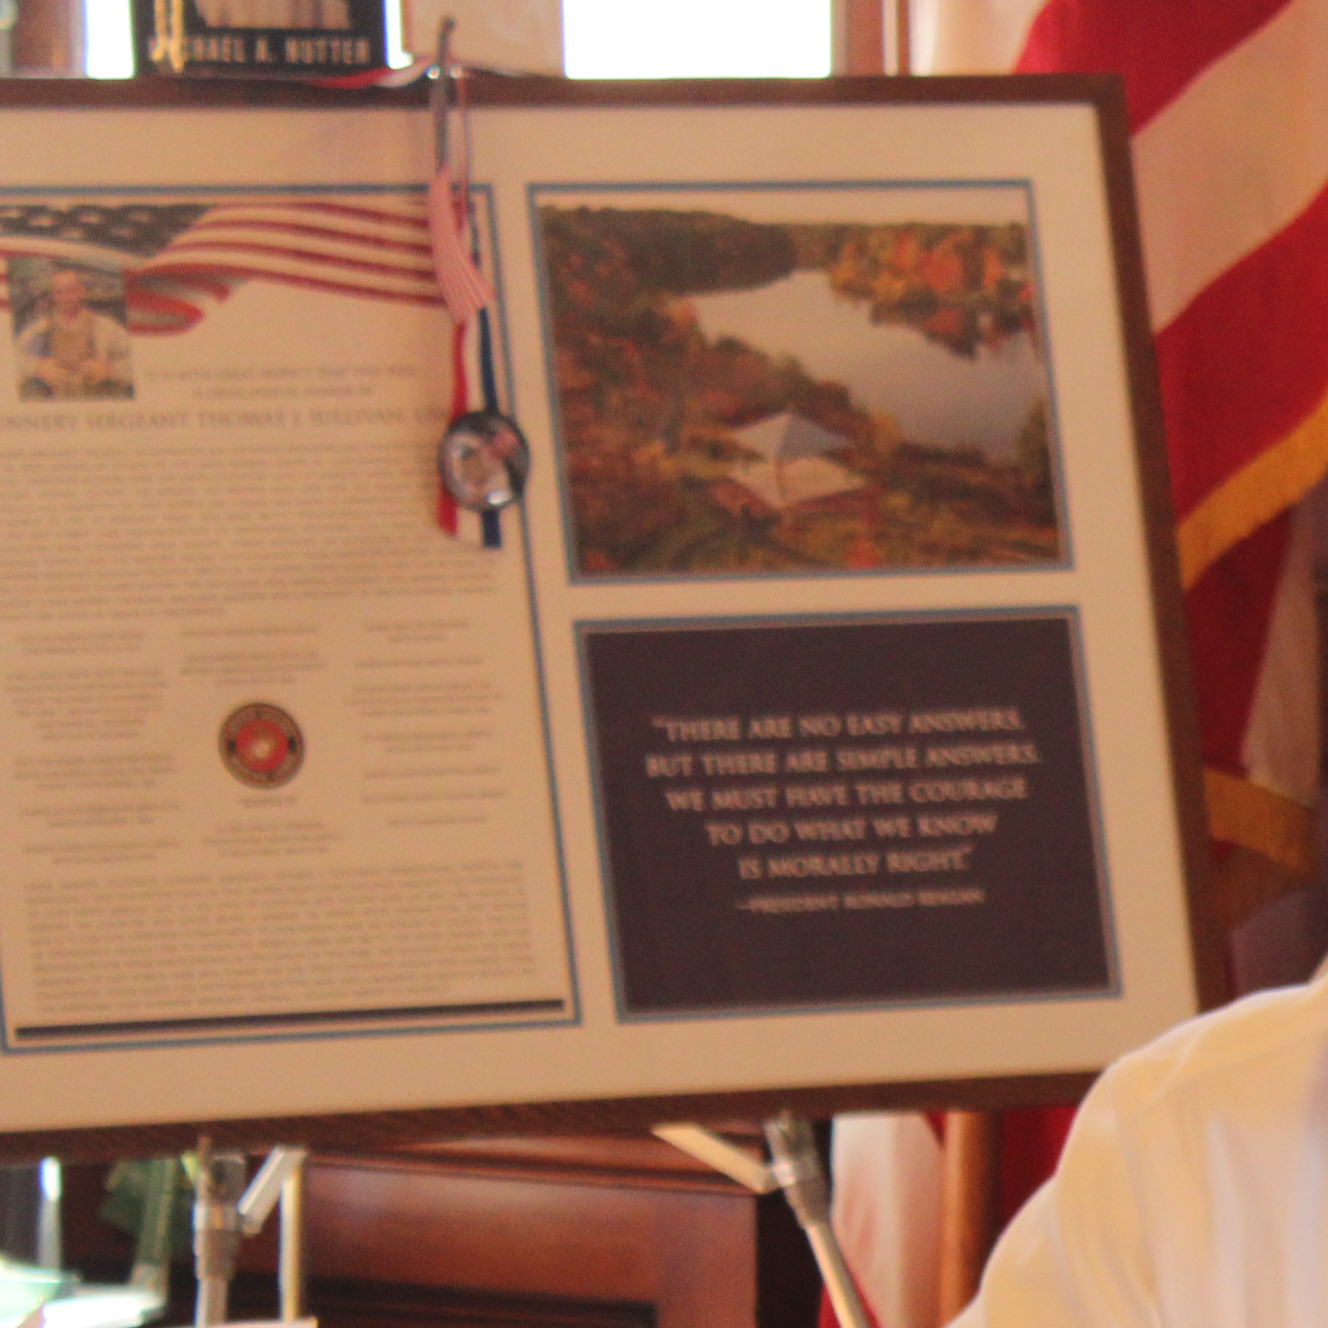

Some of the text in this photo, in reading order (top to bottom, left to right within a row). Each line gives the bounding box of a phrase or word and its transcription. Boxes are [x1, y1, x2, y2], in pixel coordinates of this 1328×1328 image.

[285, 38, 371, 64] NUTTER
[749, 716, 792, 740] ARE
[799, 714, 842, 738] NO
[846, 711, 904, 737] EASY
[646, 752, 694, 778] BUT
[700, 750, 779, 776] THERE
[785, 748, 829, 773] ARE
[836, 745, 918, 771] SIMPLE
[666, 775, 1028, 812] WE MUST HAVE THE COURAGE
[707, 812, 998, 847] TO DO WHAT WE KNOW
[738, 856, 762, 880] IS
[767, 851, 880, 879] MORALLY
